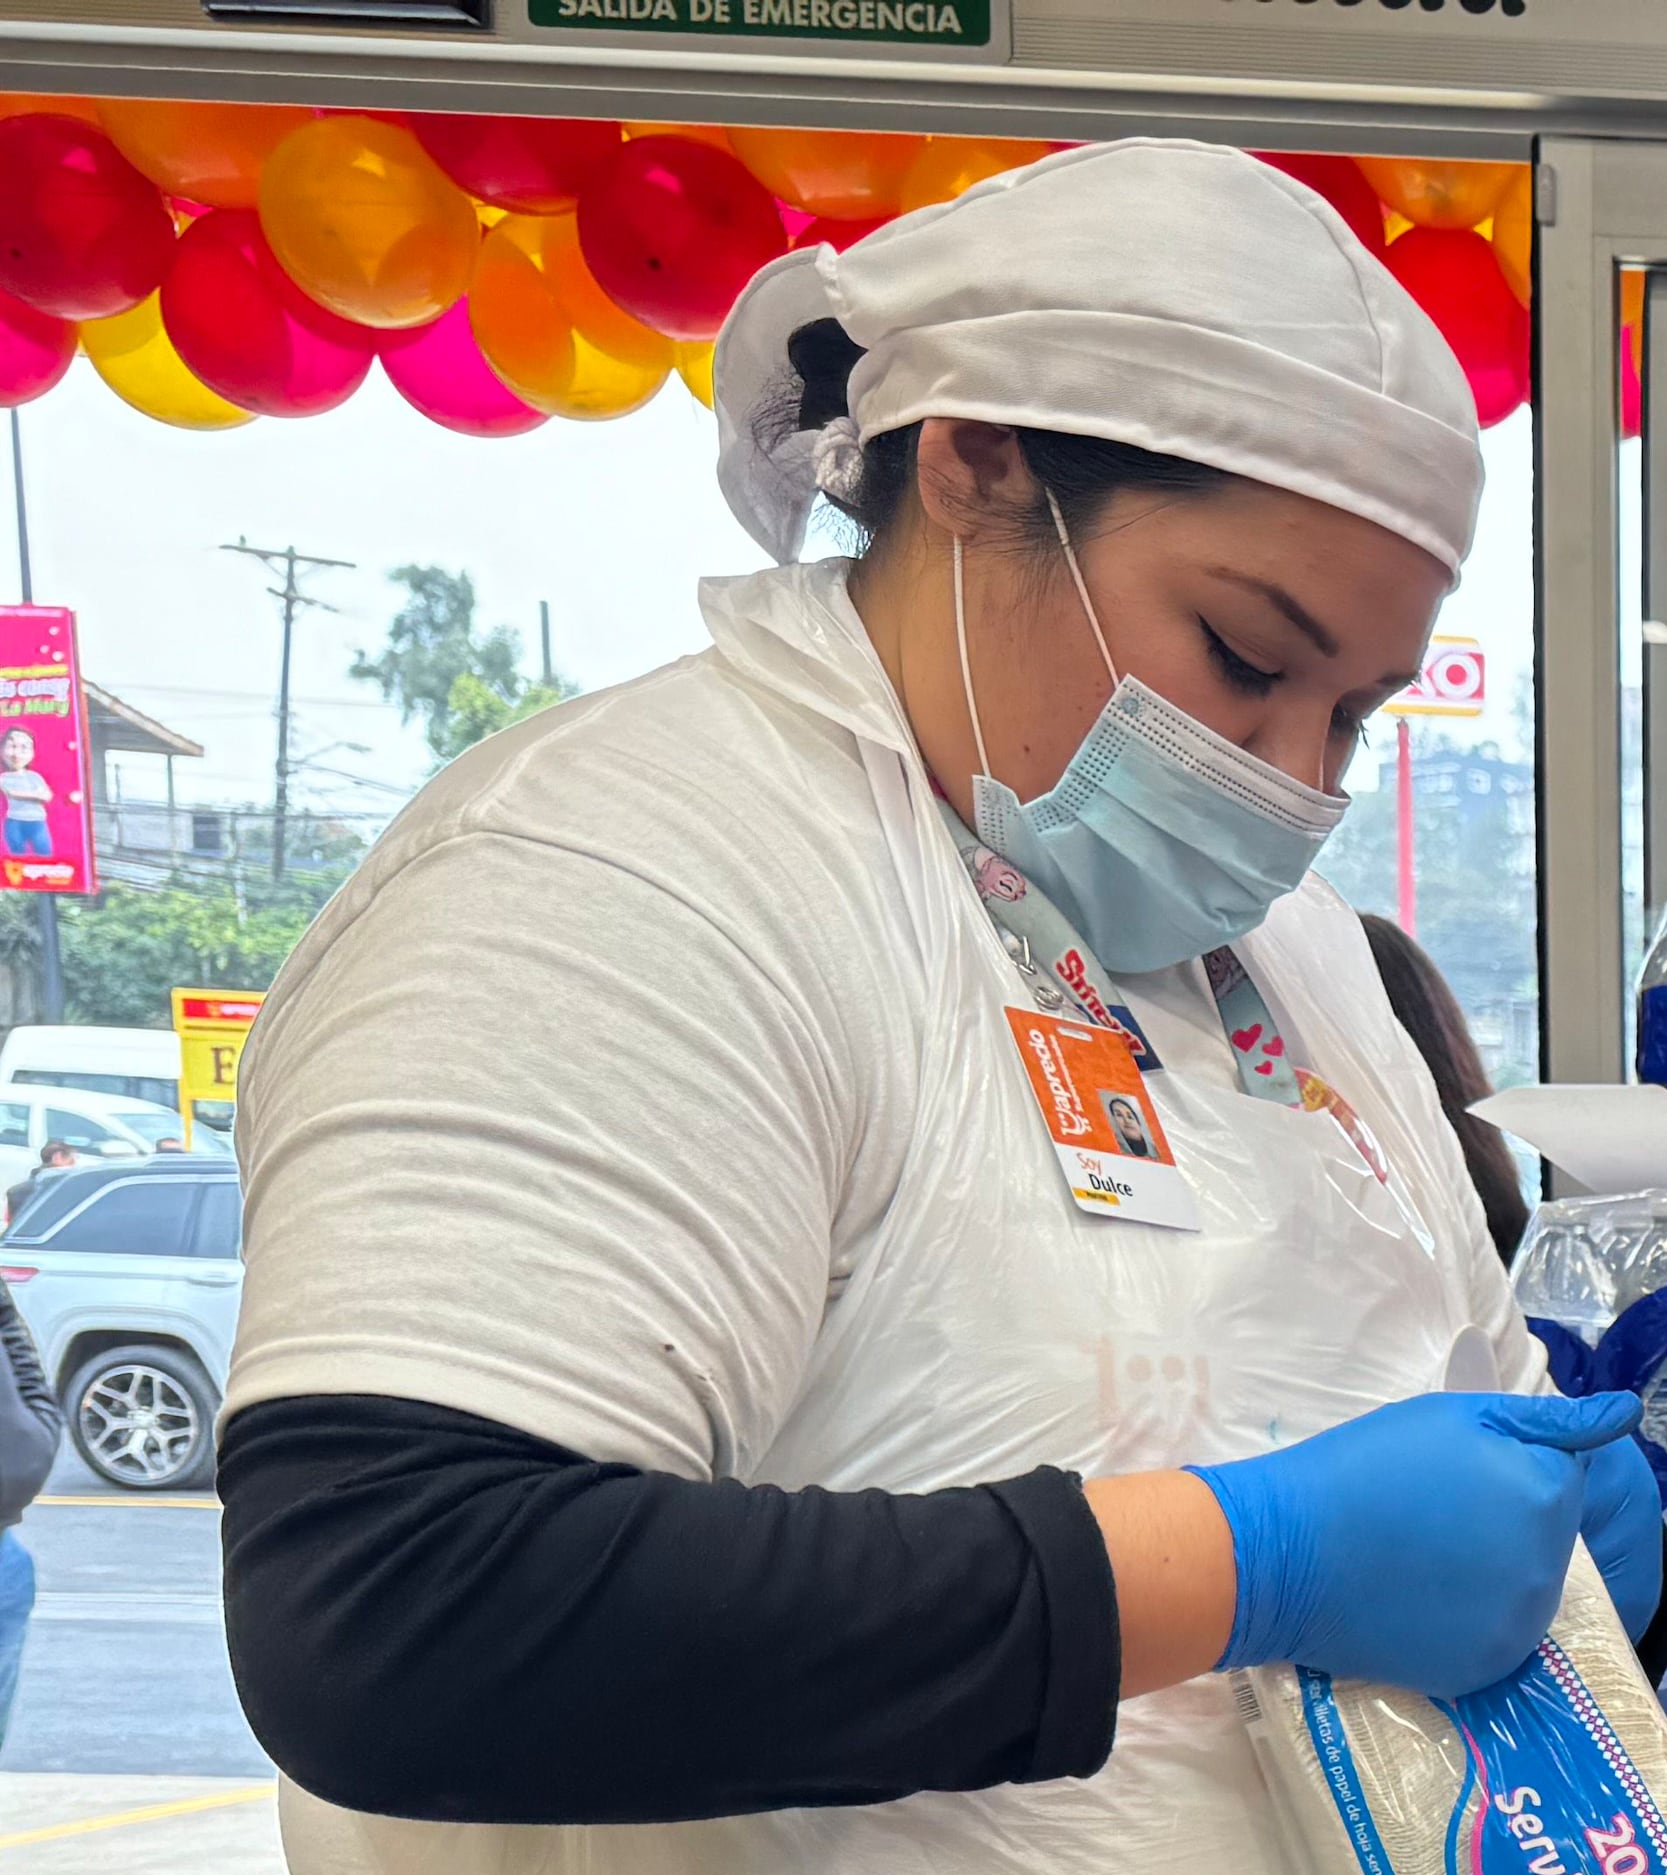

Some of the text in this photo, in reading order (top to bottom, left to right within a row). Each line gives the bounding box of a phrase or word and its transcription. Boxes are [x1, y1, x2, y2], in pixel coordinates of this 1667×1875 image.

[558, 0, 963, 34] SALIDA DE EMERGENCIA
[1076, 1153, 1103, 1175] Soy
[1089, 1174, 1133, 1197] Dulce
[1325, 1747, 1341, 1764] de
[1329, 1765, 1353, 1805] papel
[1345, 1804, 1361, 1823] de
[1353, 1822, 1374, 1854] hoja
